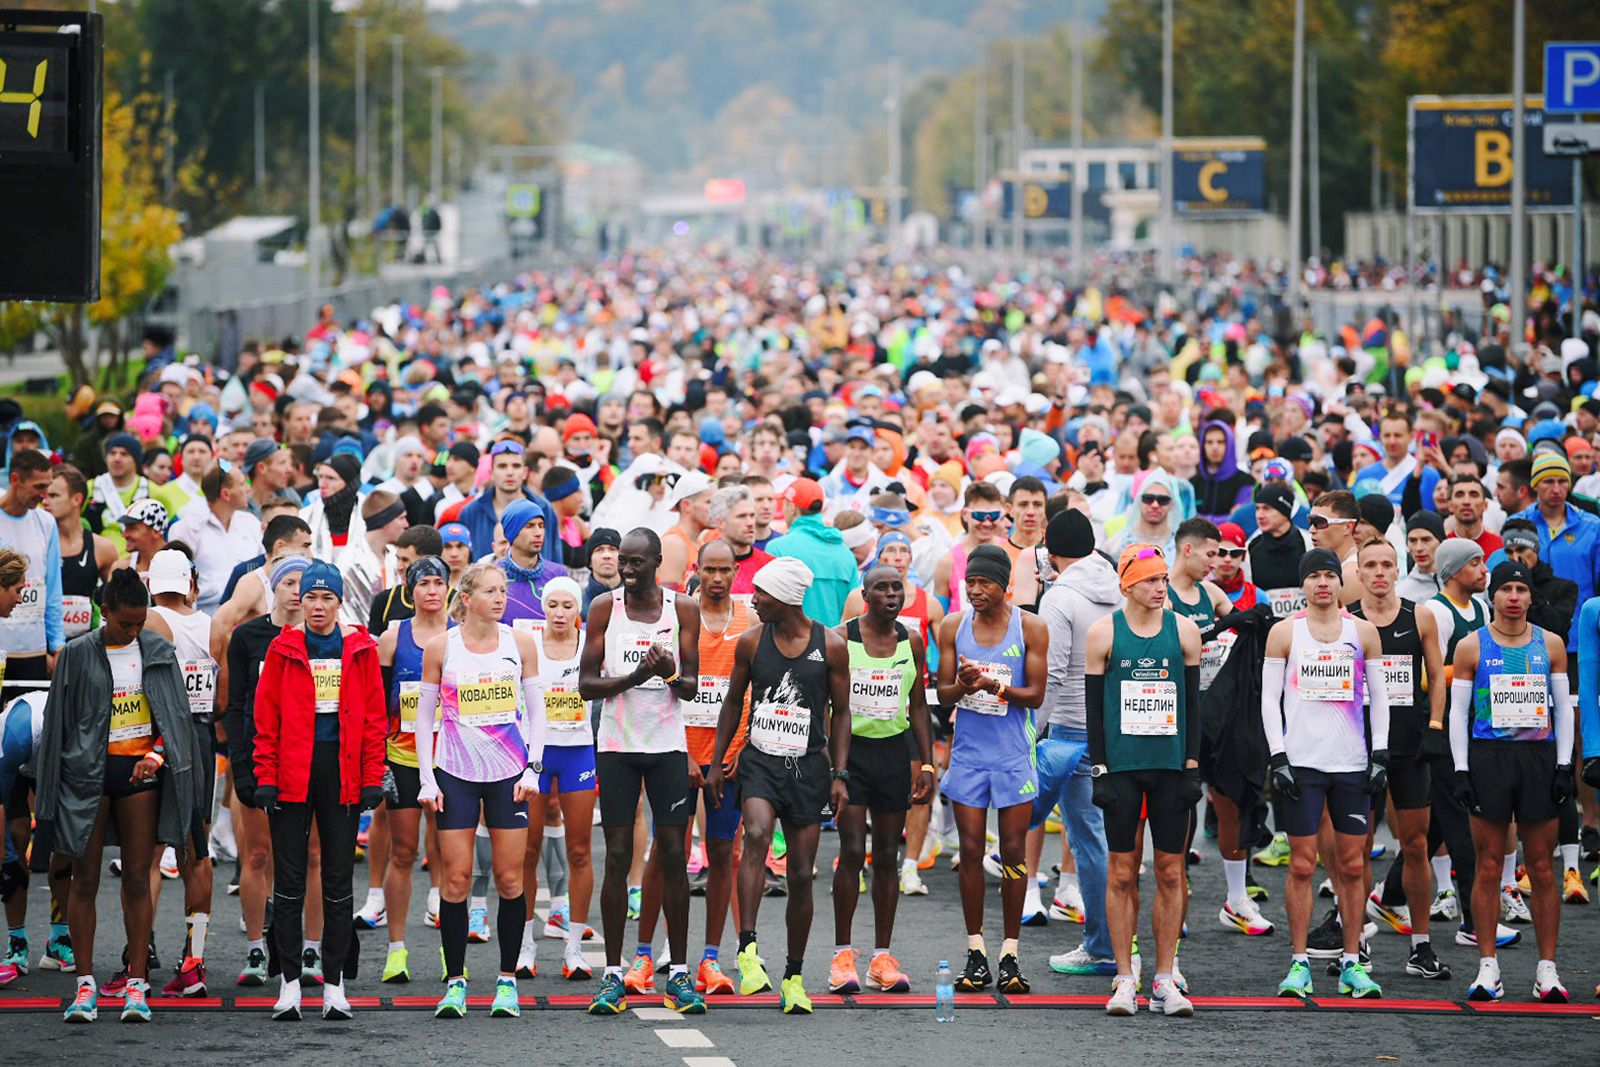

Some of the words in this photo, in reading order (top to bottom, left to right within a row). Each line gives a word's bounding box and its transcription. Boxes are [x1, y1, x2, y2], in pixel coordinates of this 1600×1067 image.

[1564, 50, 1600, 105] P
[0, 58, 48, 138] 4
[1475, 130, 1514, 187] B
[1198, 160, 1228, 202] C
[1301, 665, 1350, 678] МИНШИН
[1384, 671, 1410, 683] ЗНЕВ
[460, 684, 514, 703] КОВАЛЁВА
[852, 682, 899, 697] CHUMBA
[1493, 691, 1546, 704] ХОРОШИЛОВ
[1124, 698, 1175, 713] НЕДЕЛИН
[753, 714, 809, 737] MUNYWOKI
